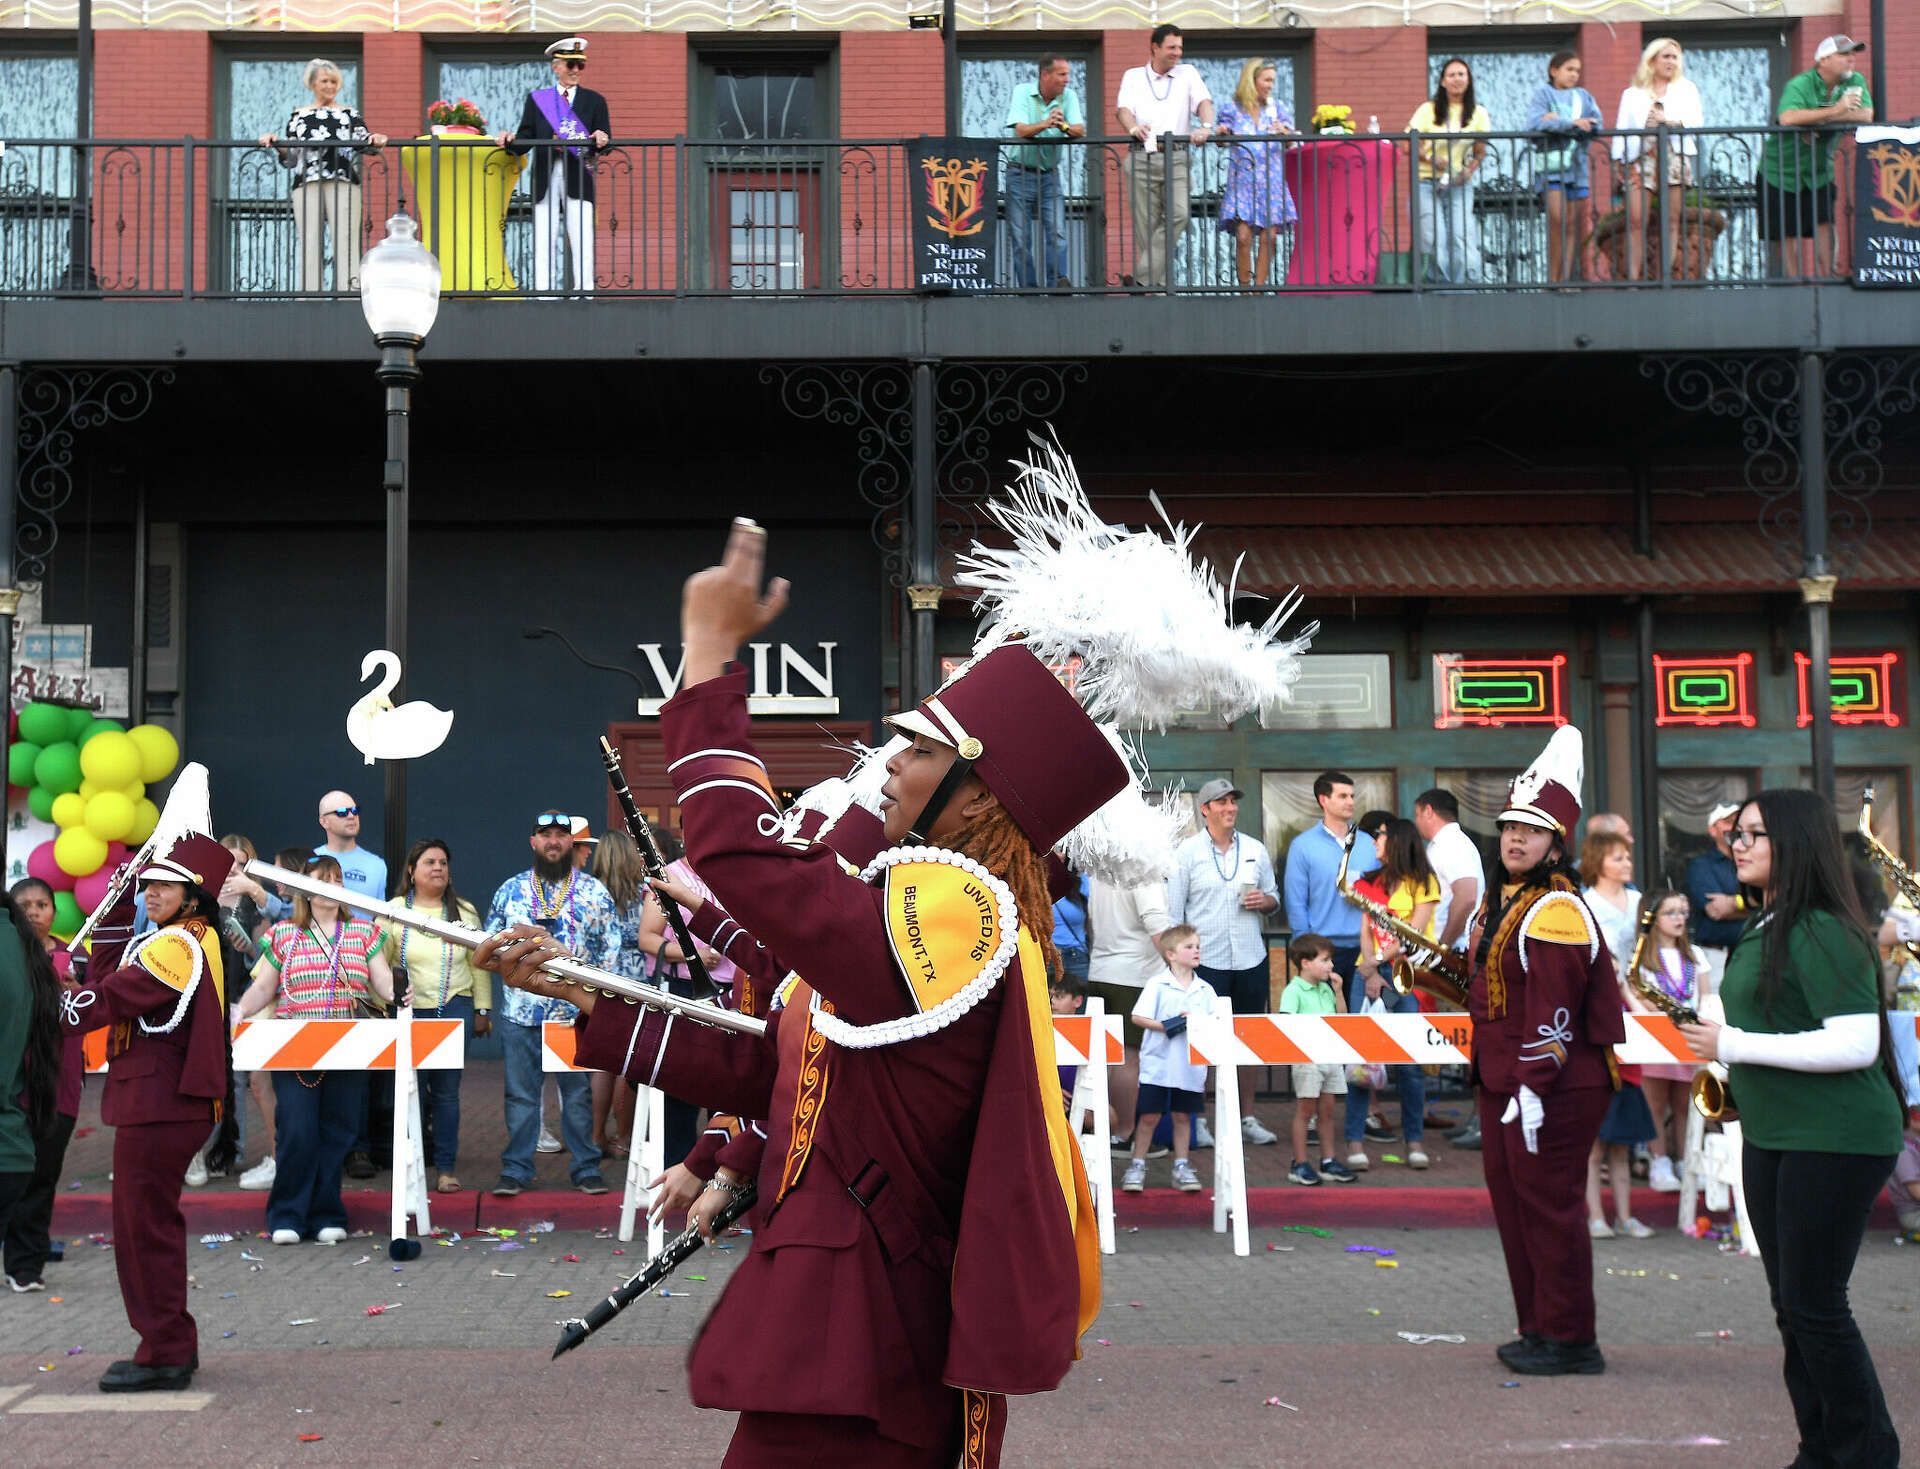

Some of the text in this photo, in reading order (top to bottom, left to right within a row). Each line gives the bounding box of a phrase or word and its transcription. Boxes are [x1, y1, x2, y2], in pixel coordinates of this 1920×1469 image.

[926, 243, 987, 260] NEHES
[921, 272, 992, 290] FESIVAL
[904, 885, 937, 984] BEAUMONT, TX
[963, 882, 994, 962] UNITED HS
